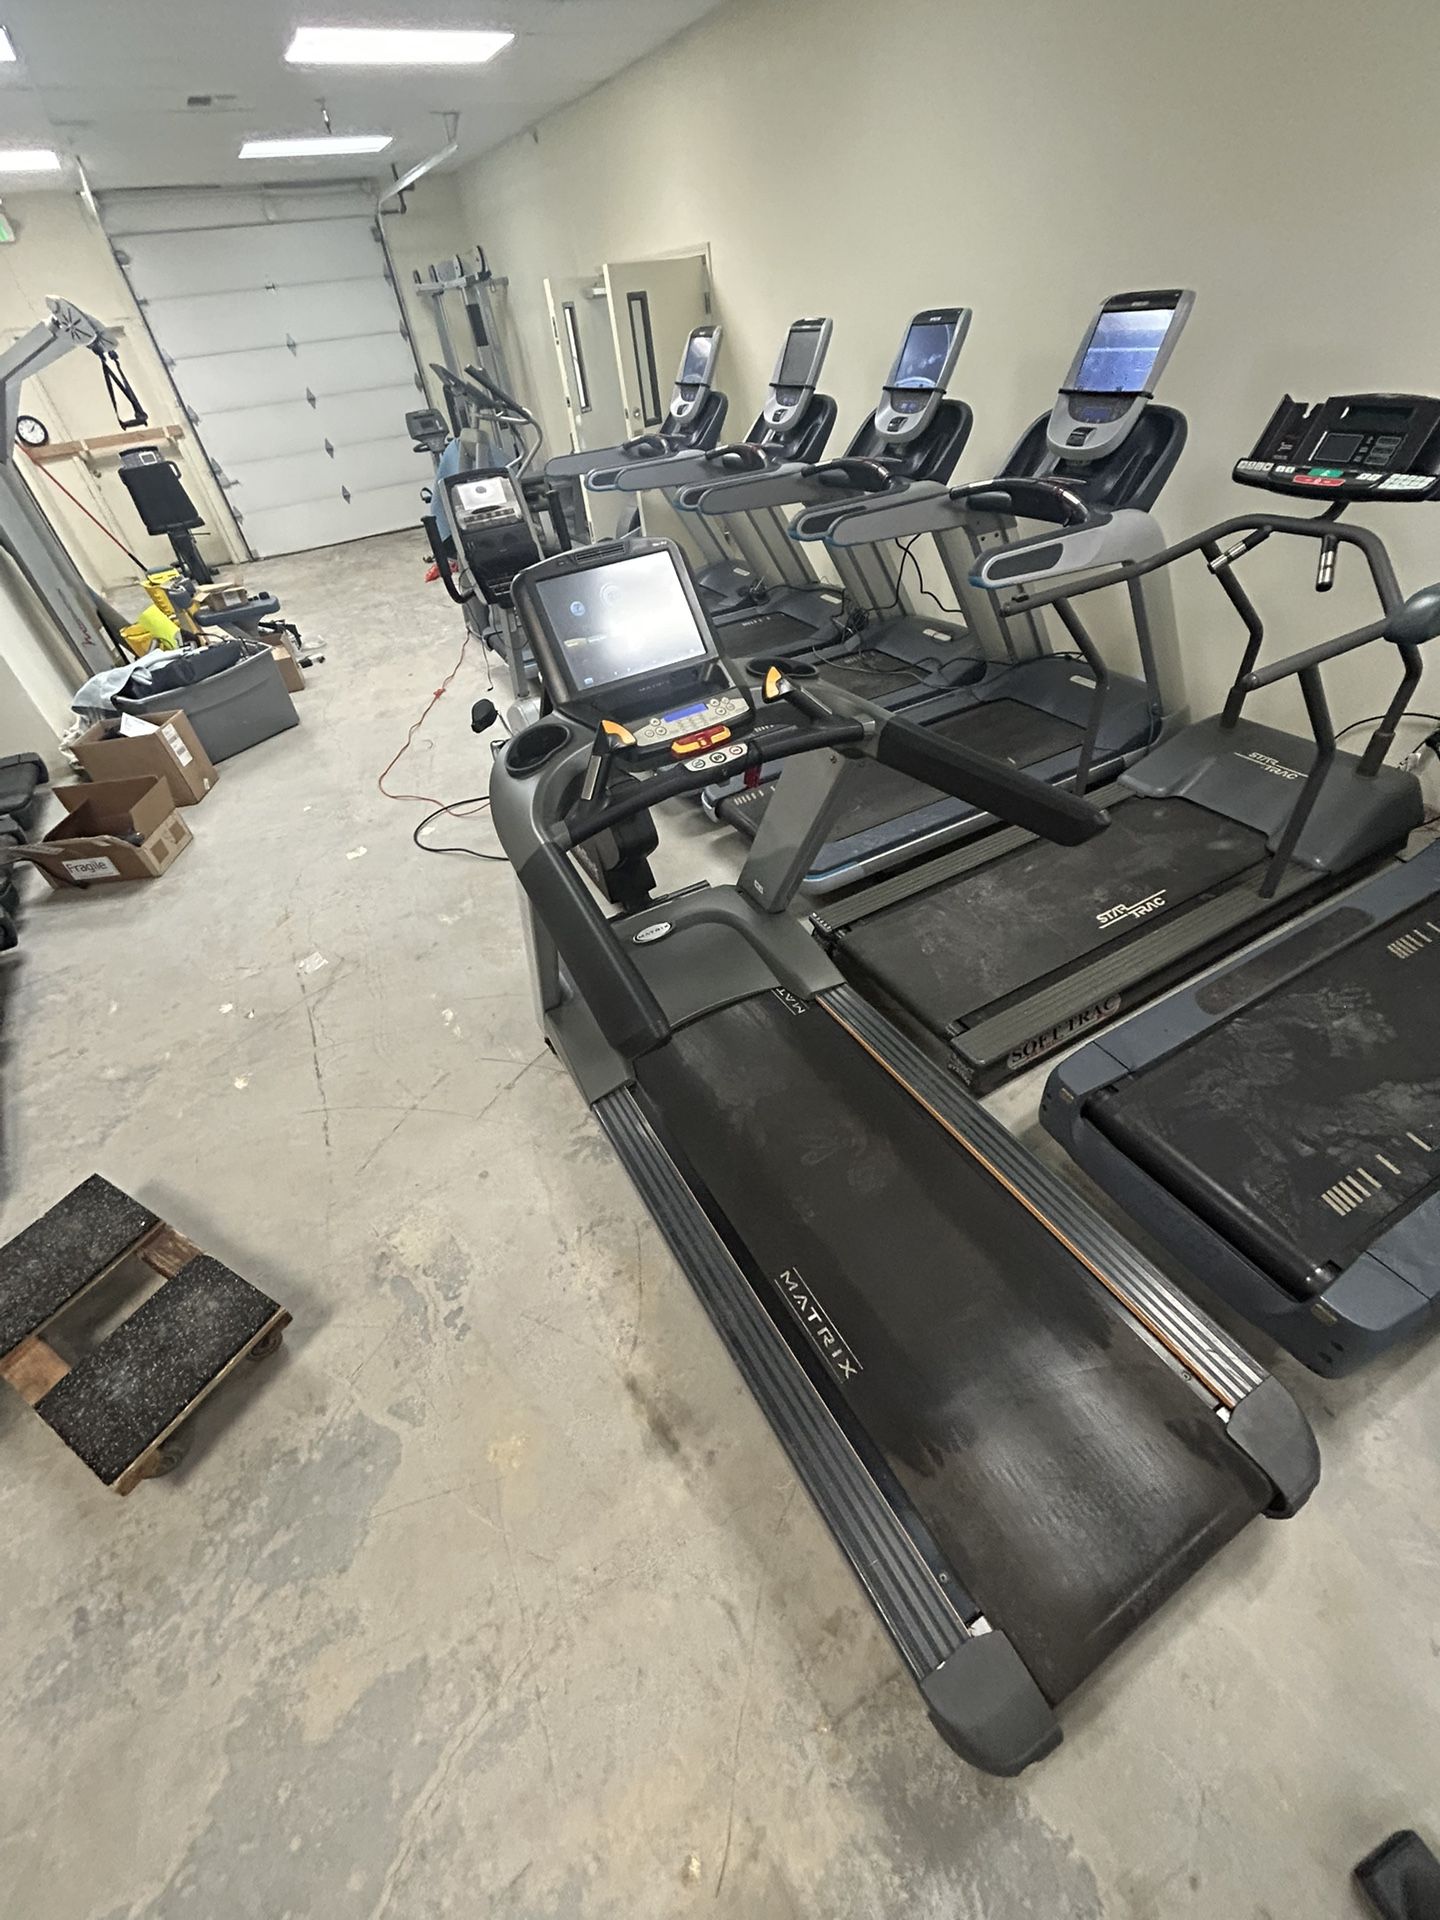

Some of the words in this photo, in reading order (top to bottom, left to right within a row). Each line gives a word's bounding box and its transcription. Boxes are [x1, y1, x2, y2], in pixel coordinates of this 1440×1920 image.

[1248, 752, 1279, 766] STAR
[1264, 765, 1299, 779] TRAC
[66, 861, 108, 874] Fragile
[1096, 903, 1129, 923] STAR
[1128, 897, 1166, 918] TRAC
[1011, 1026, 1063, 1063] SOFT
[1064, 995, 1117, 1031] TRAC
[780, 1270, 858, 1379] MATRIX
